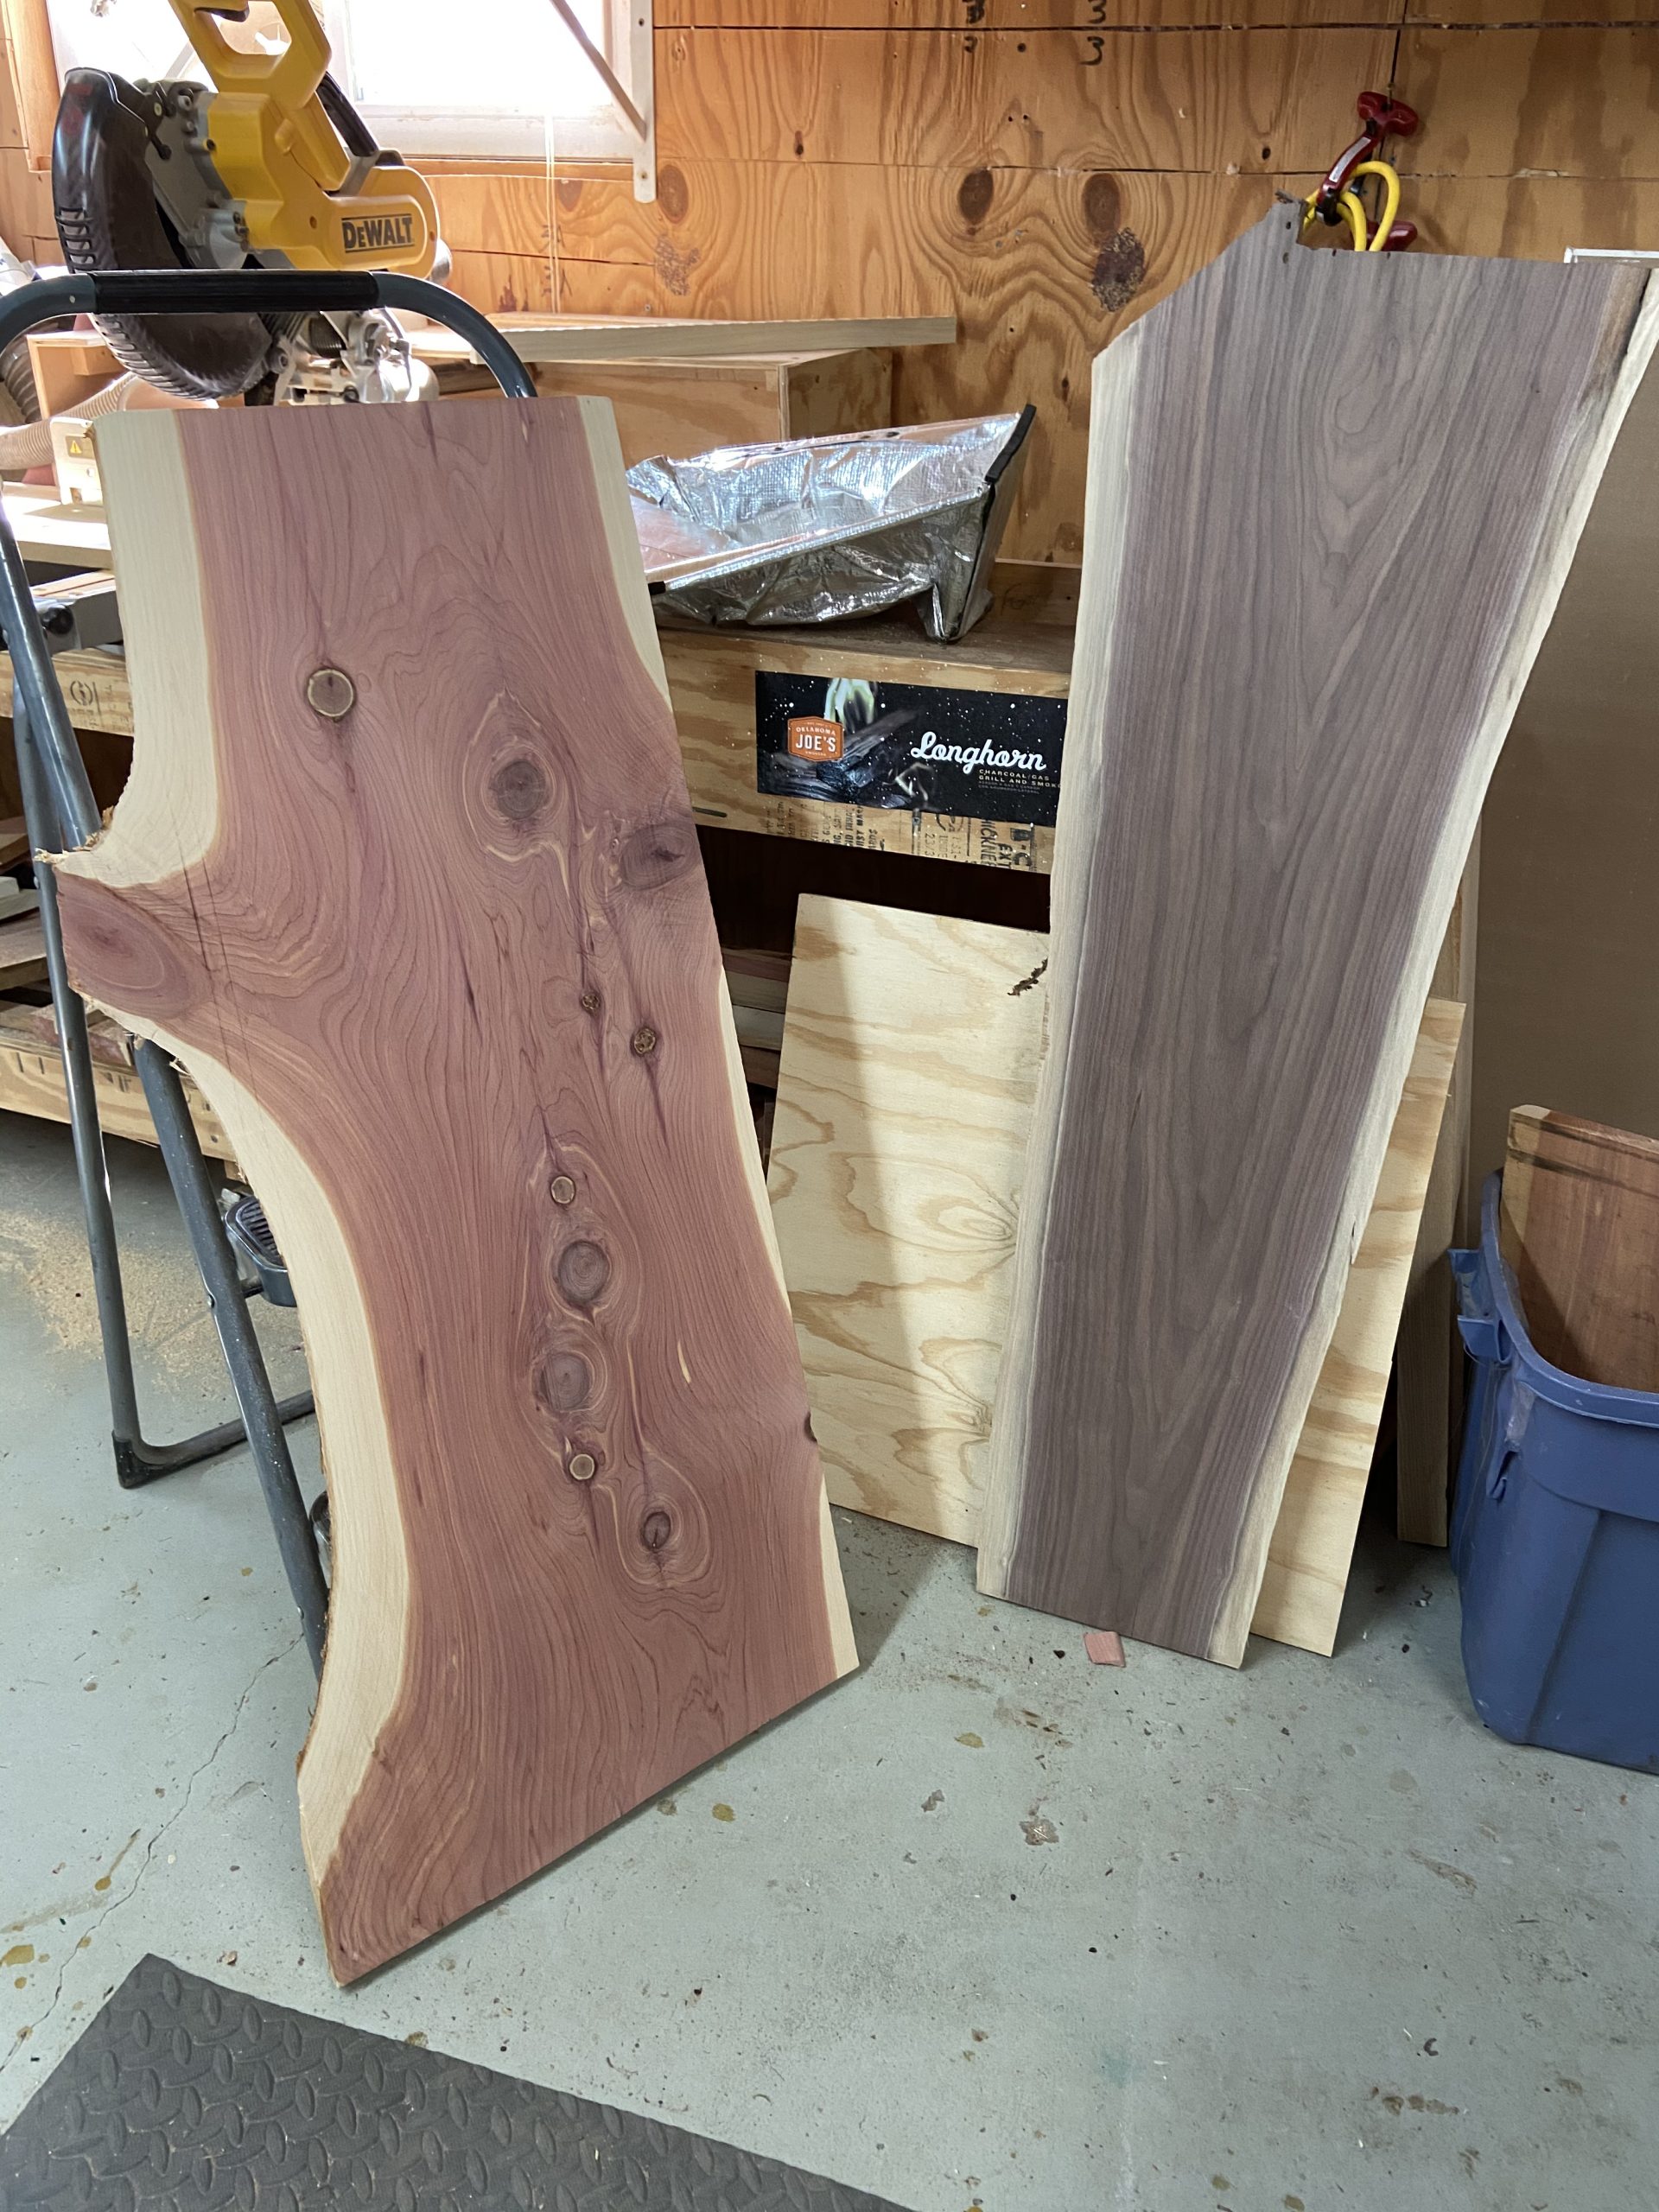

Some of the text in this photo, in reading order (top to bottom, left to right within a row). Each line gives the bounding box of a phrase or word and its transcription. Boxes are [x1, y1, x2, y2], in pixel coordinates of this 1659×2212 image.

[796, 727, 836, 736] OKLAHOMA
[796, 734, 836, 753] JOE'S
[910, 731, 1047, 774] Longhorn
